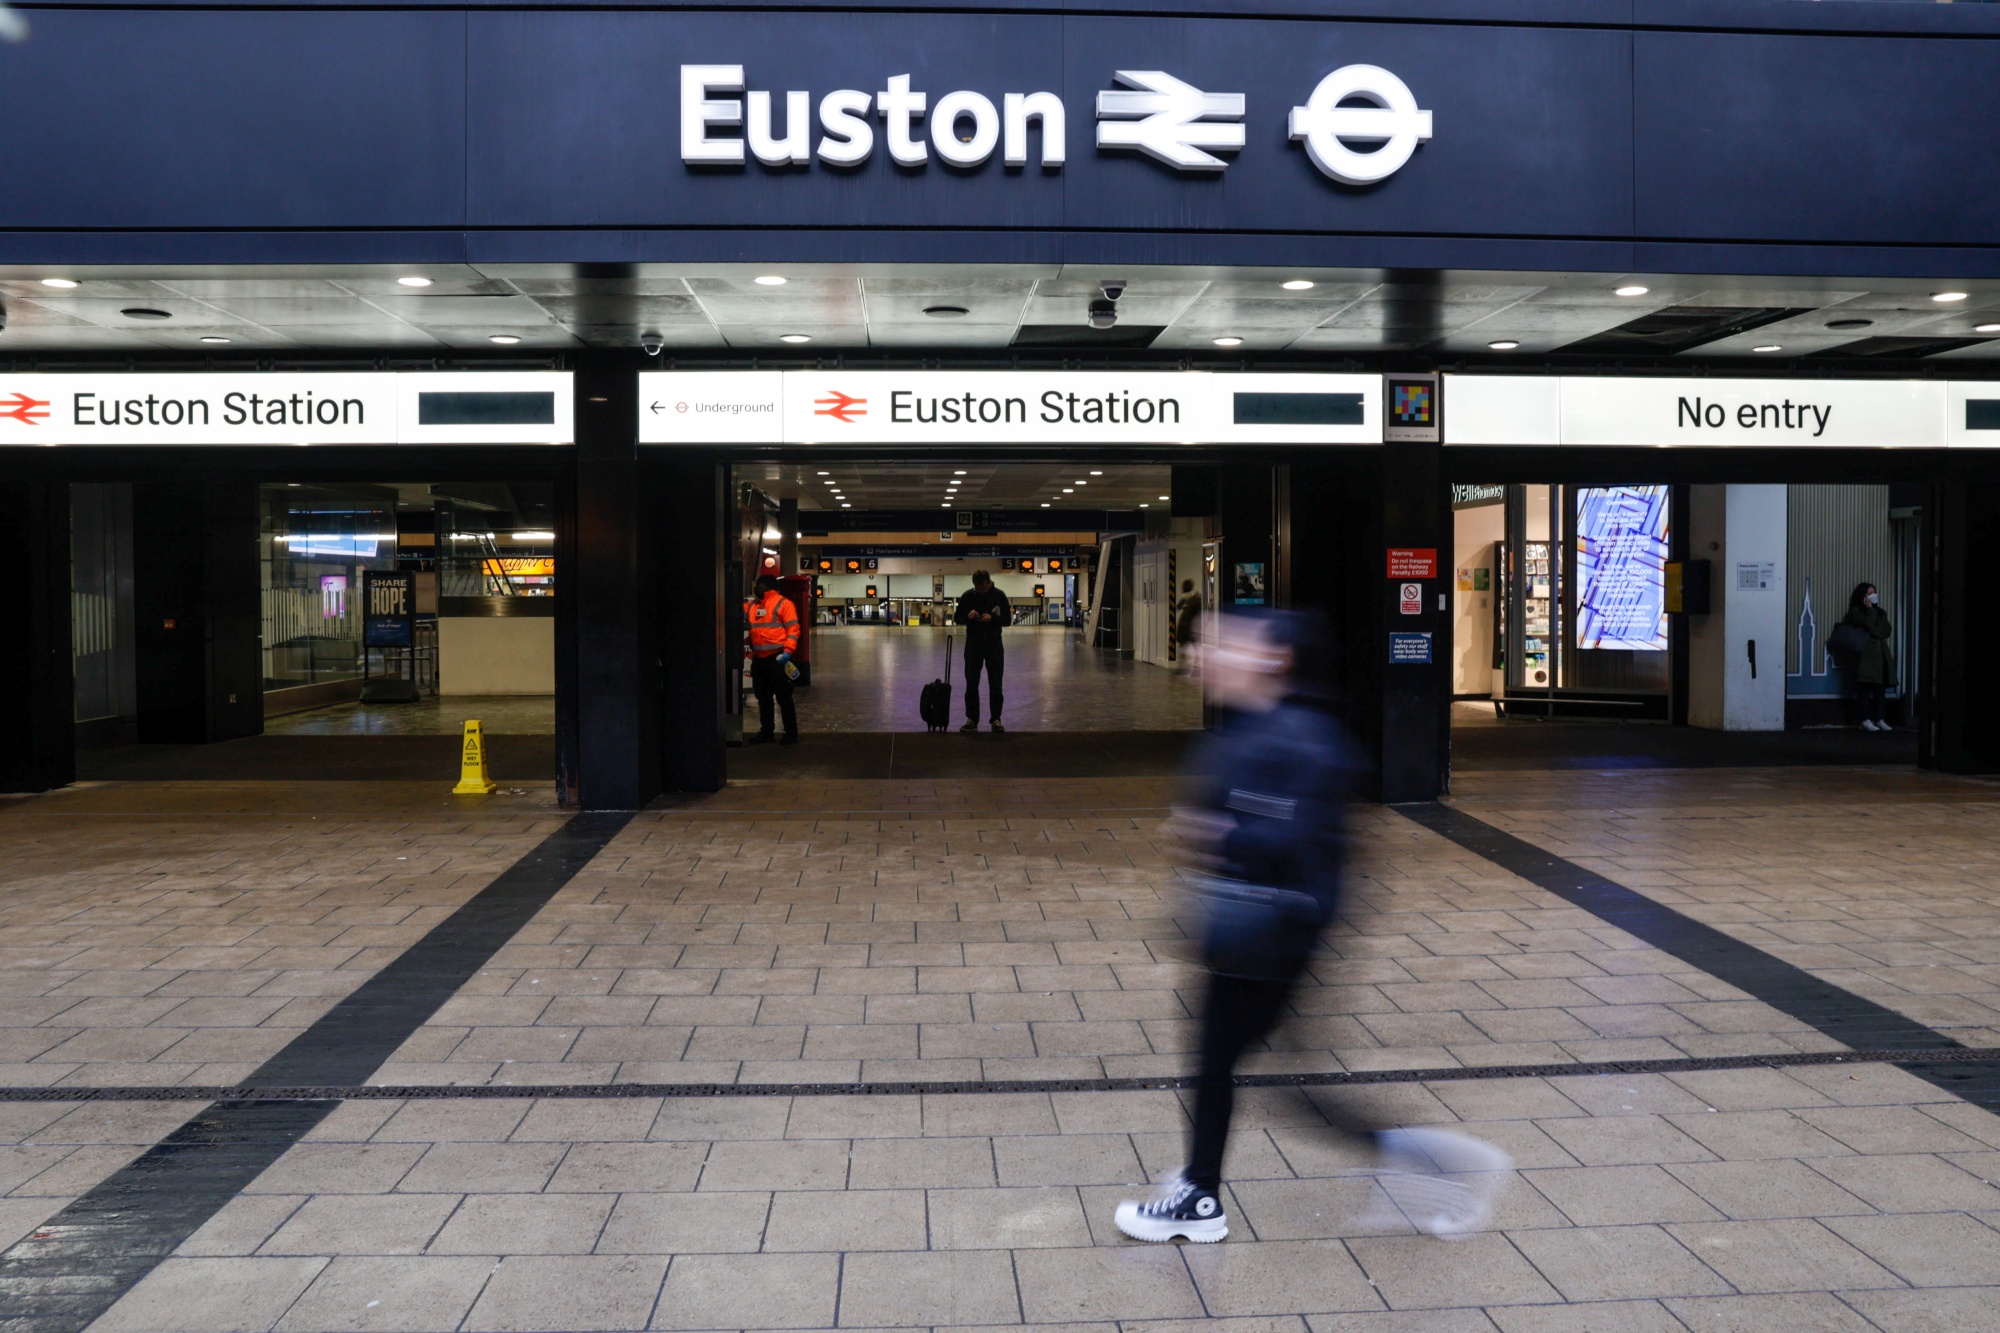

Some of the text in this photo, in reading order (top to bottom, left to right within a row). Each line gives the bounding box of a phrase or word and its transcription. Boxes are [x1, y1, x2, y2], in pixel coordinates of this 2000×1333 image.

[680, 63, 1066, 169] Euston
[73, 390, 364, 425] Euston Station
[695, 402, 774, 415] Underground
[890, 389, 1180, 424] Euston Station
[1677, 396, 1832, 437] No entry
[1451, 482, 1474, 503] Well
[803, 559, 810, 568] 7
[868, 559, 876, 569] 6
[1006, 559, 1013, 568] 5
[1070, 559, 1077, 568] 4
[371, 579, 407, 587] SHARE
[371, 587, 407, 615] HOPE
